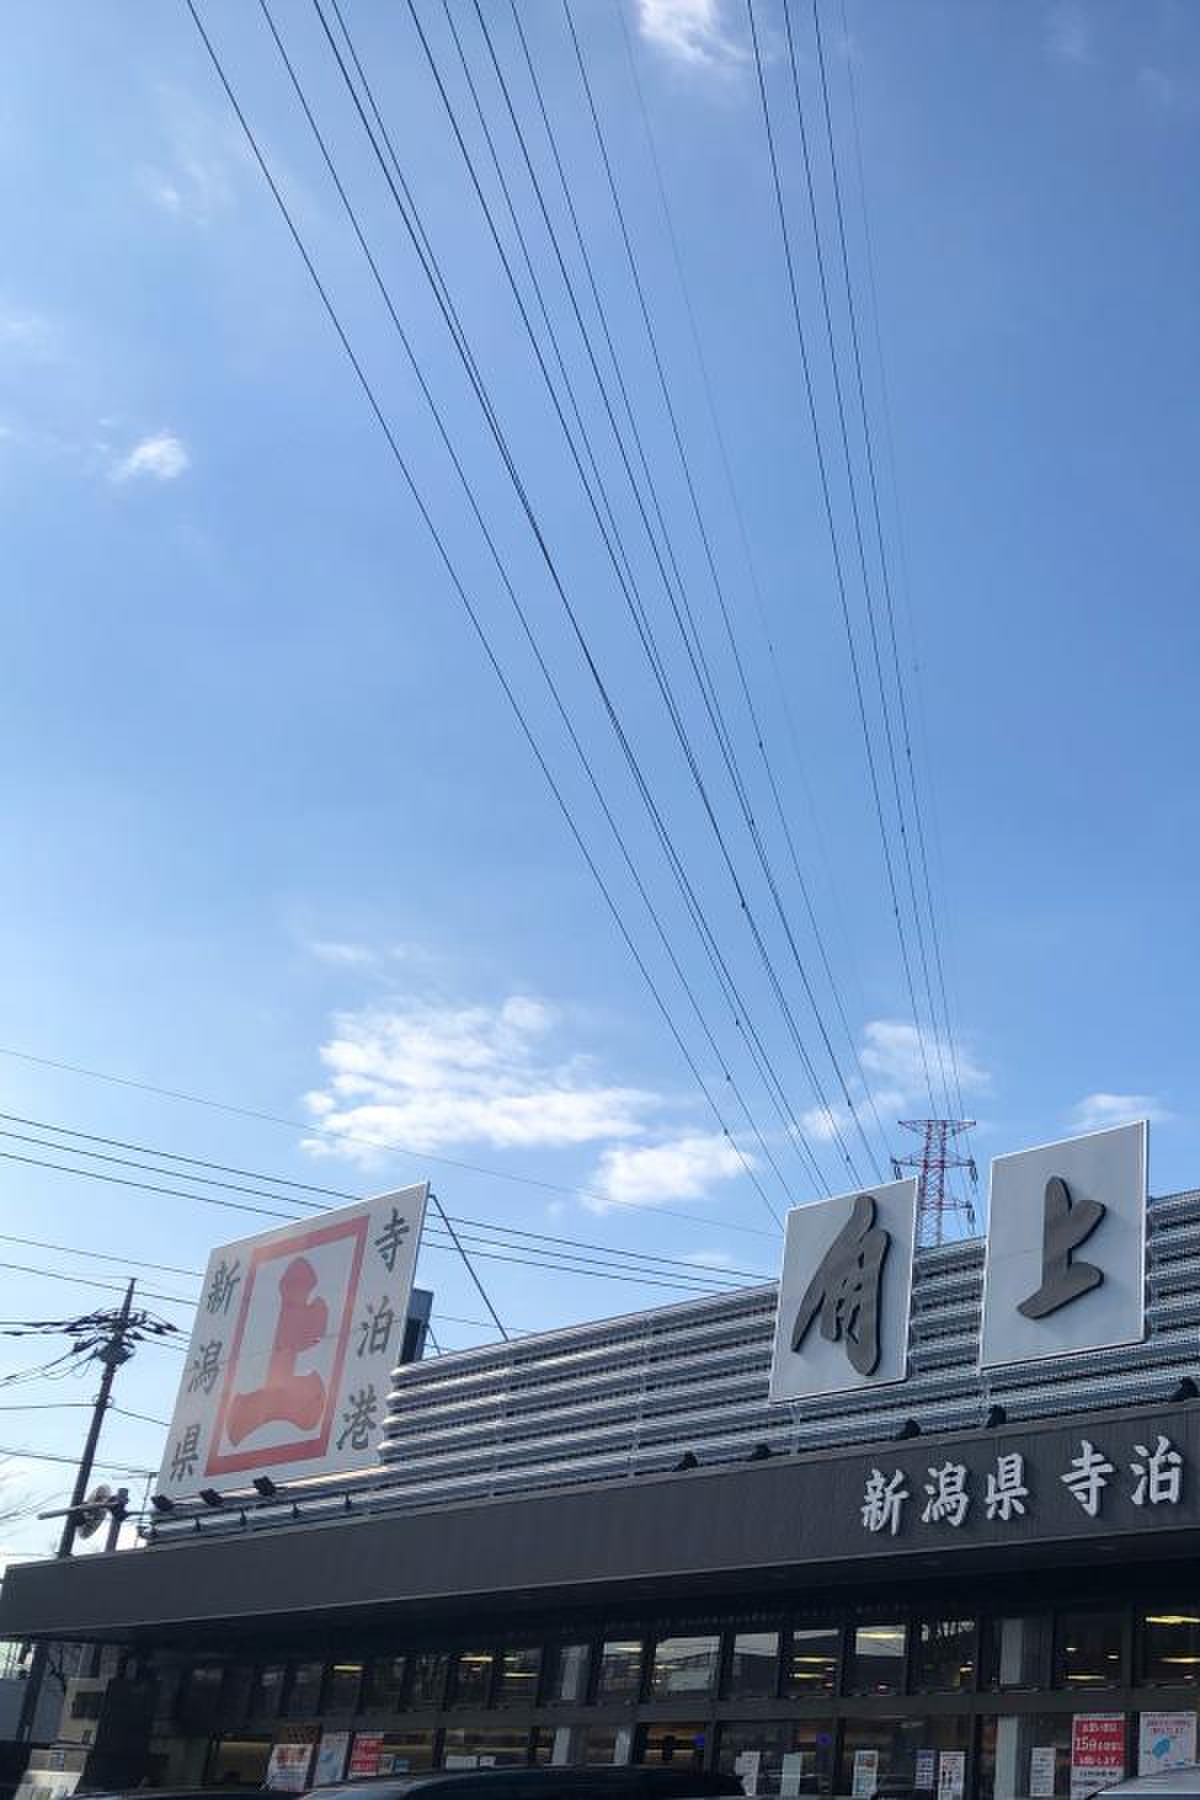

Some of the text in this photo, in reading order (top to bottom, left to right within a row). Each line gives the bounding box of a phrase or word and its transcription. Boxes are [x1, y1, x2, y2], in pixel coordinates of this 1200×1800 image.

[169, 1258, 241, 1482] 新潟県
[336, 1207, 411, 1451] 寺泊港
[859, 1452, 1030, 1536] 新潟県
